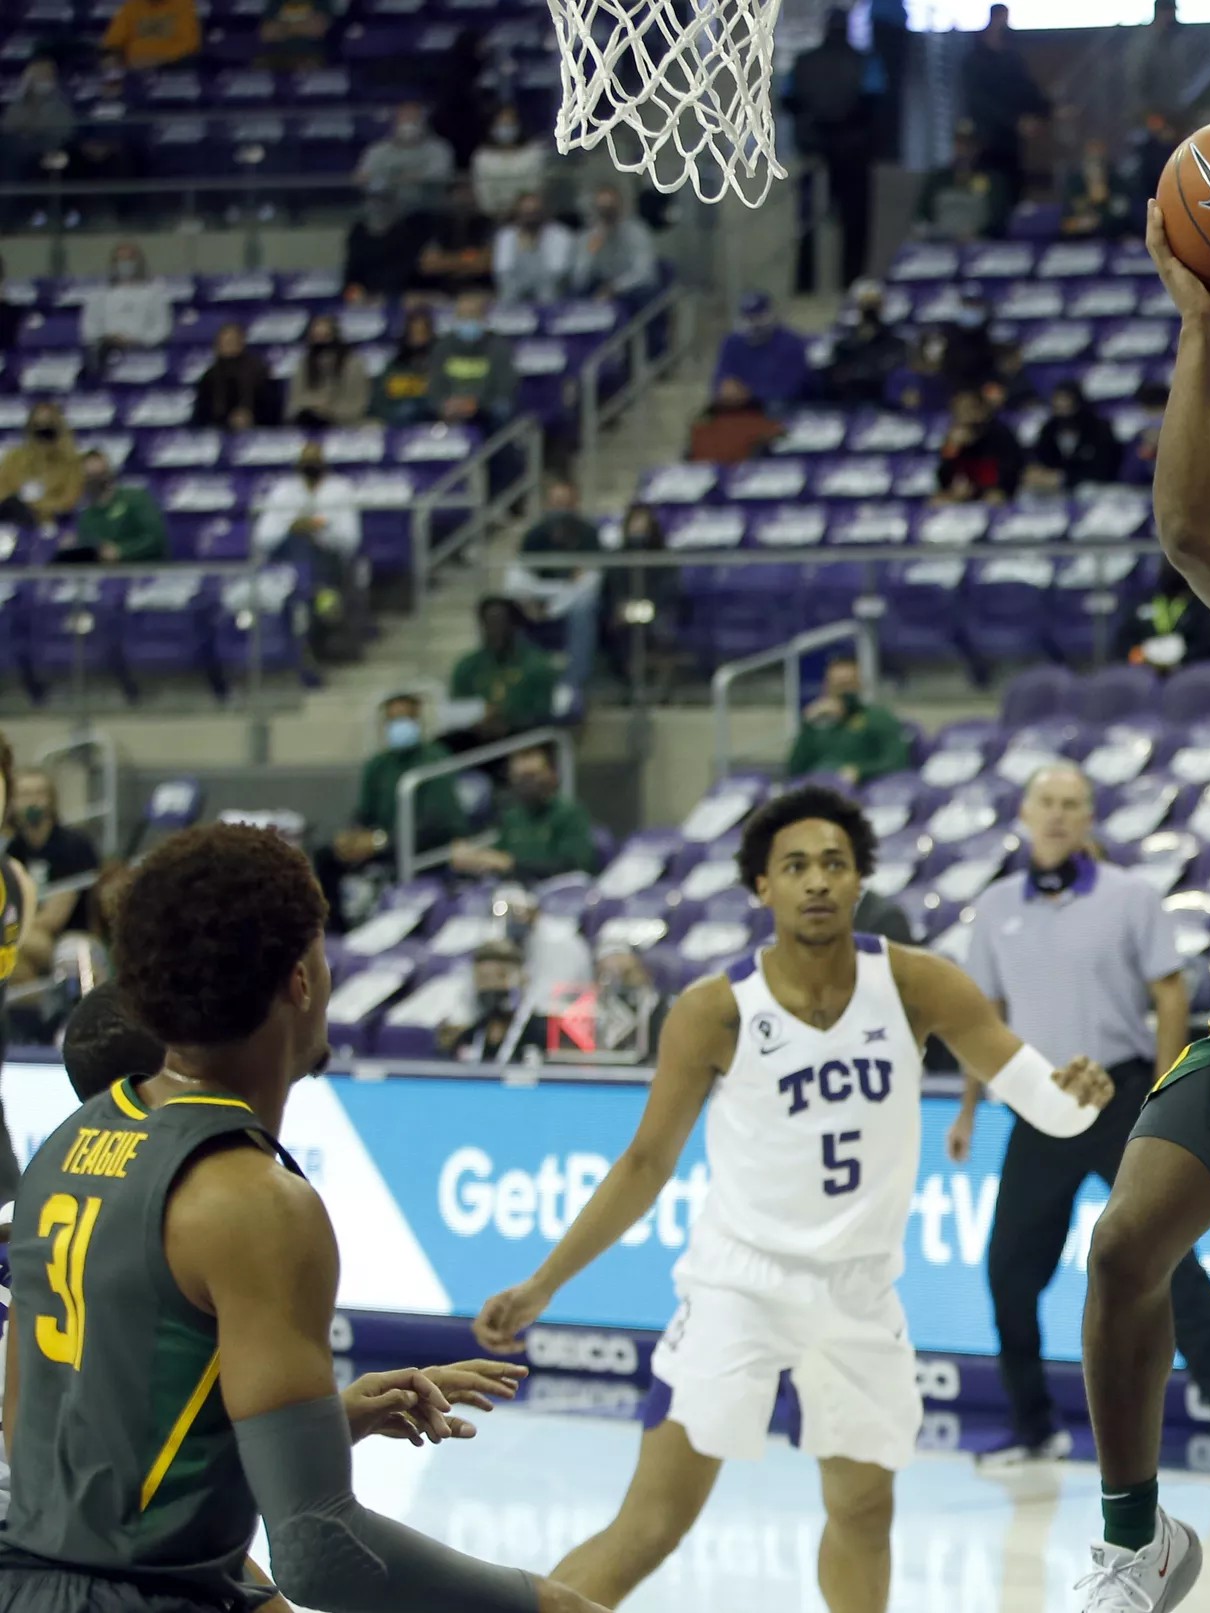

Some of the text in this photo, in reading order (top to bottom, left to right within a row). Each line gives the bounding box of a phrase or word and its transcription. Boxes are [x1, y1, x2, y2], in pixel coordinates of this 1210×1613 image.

[778, 1057, 893, 1117] TCU
[61, 1127, 149, 1179] TEAGUE
[821, 1130, 862, 1197] 5
[34, 1192, 103, 1372] 31
